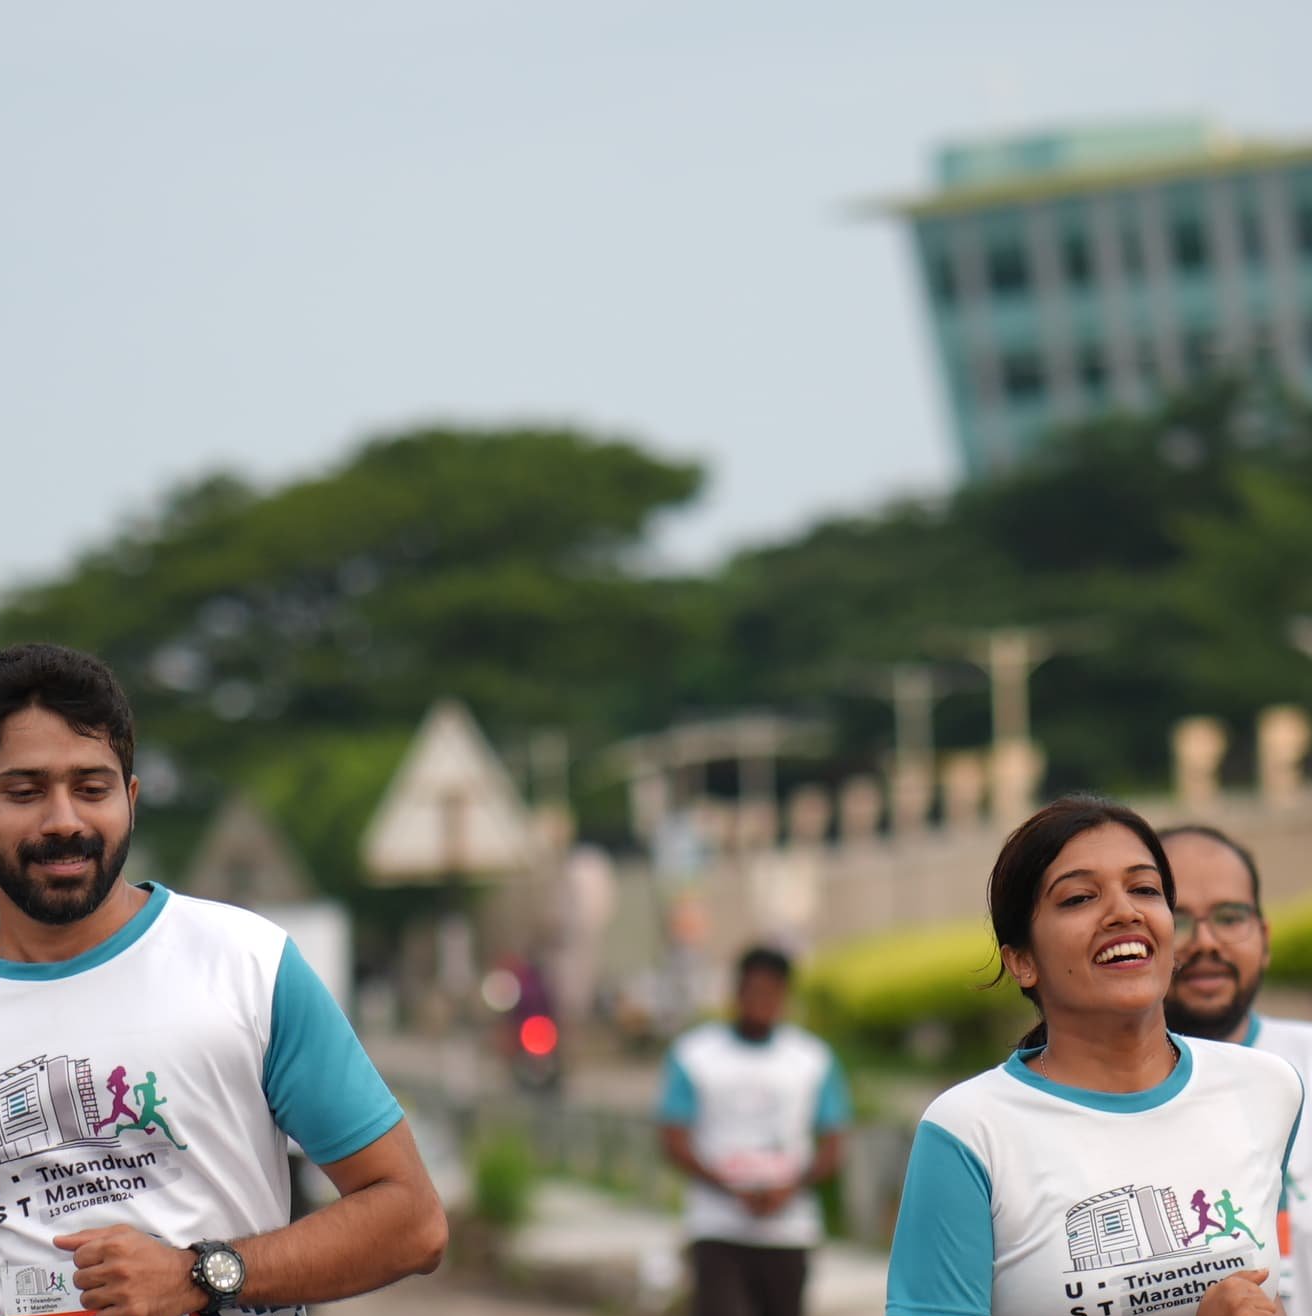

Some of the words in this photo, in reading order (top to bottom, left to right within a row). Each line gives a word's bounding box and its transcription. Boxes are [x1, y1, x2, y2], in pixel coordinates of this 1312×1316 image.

[36, 1151, 157, 1183] Trivandrum
[45, 1175, 147, 1206] Marathon
[49, 1204, 62, 1218] 13
[62, 1196, 109, 1213] OCTOBER
[1124, 1256, 1245, 1290] Trivandrum
[1129, 1279, 1223, 1307] Marath
[1146, 1297, 1193, 1313] OCTOBER
